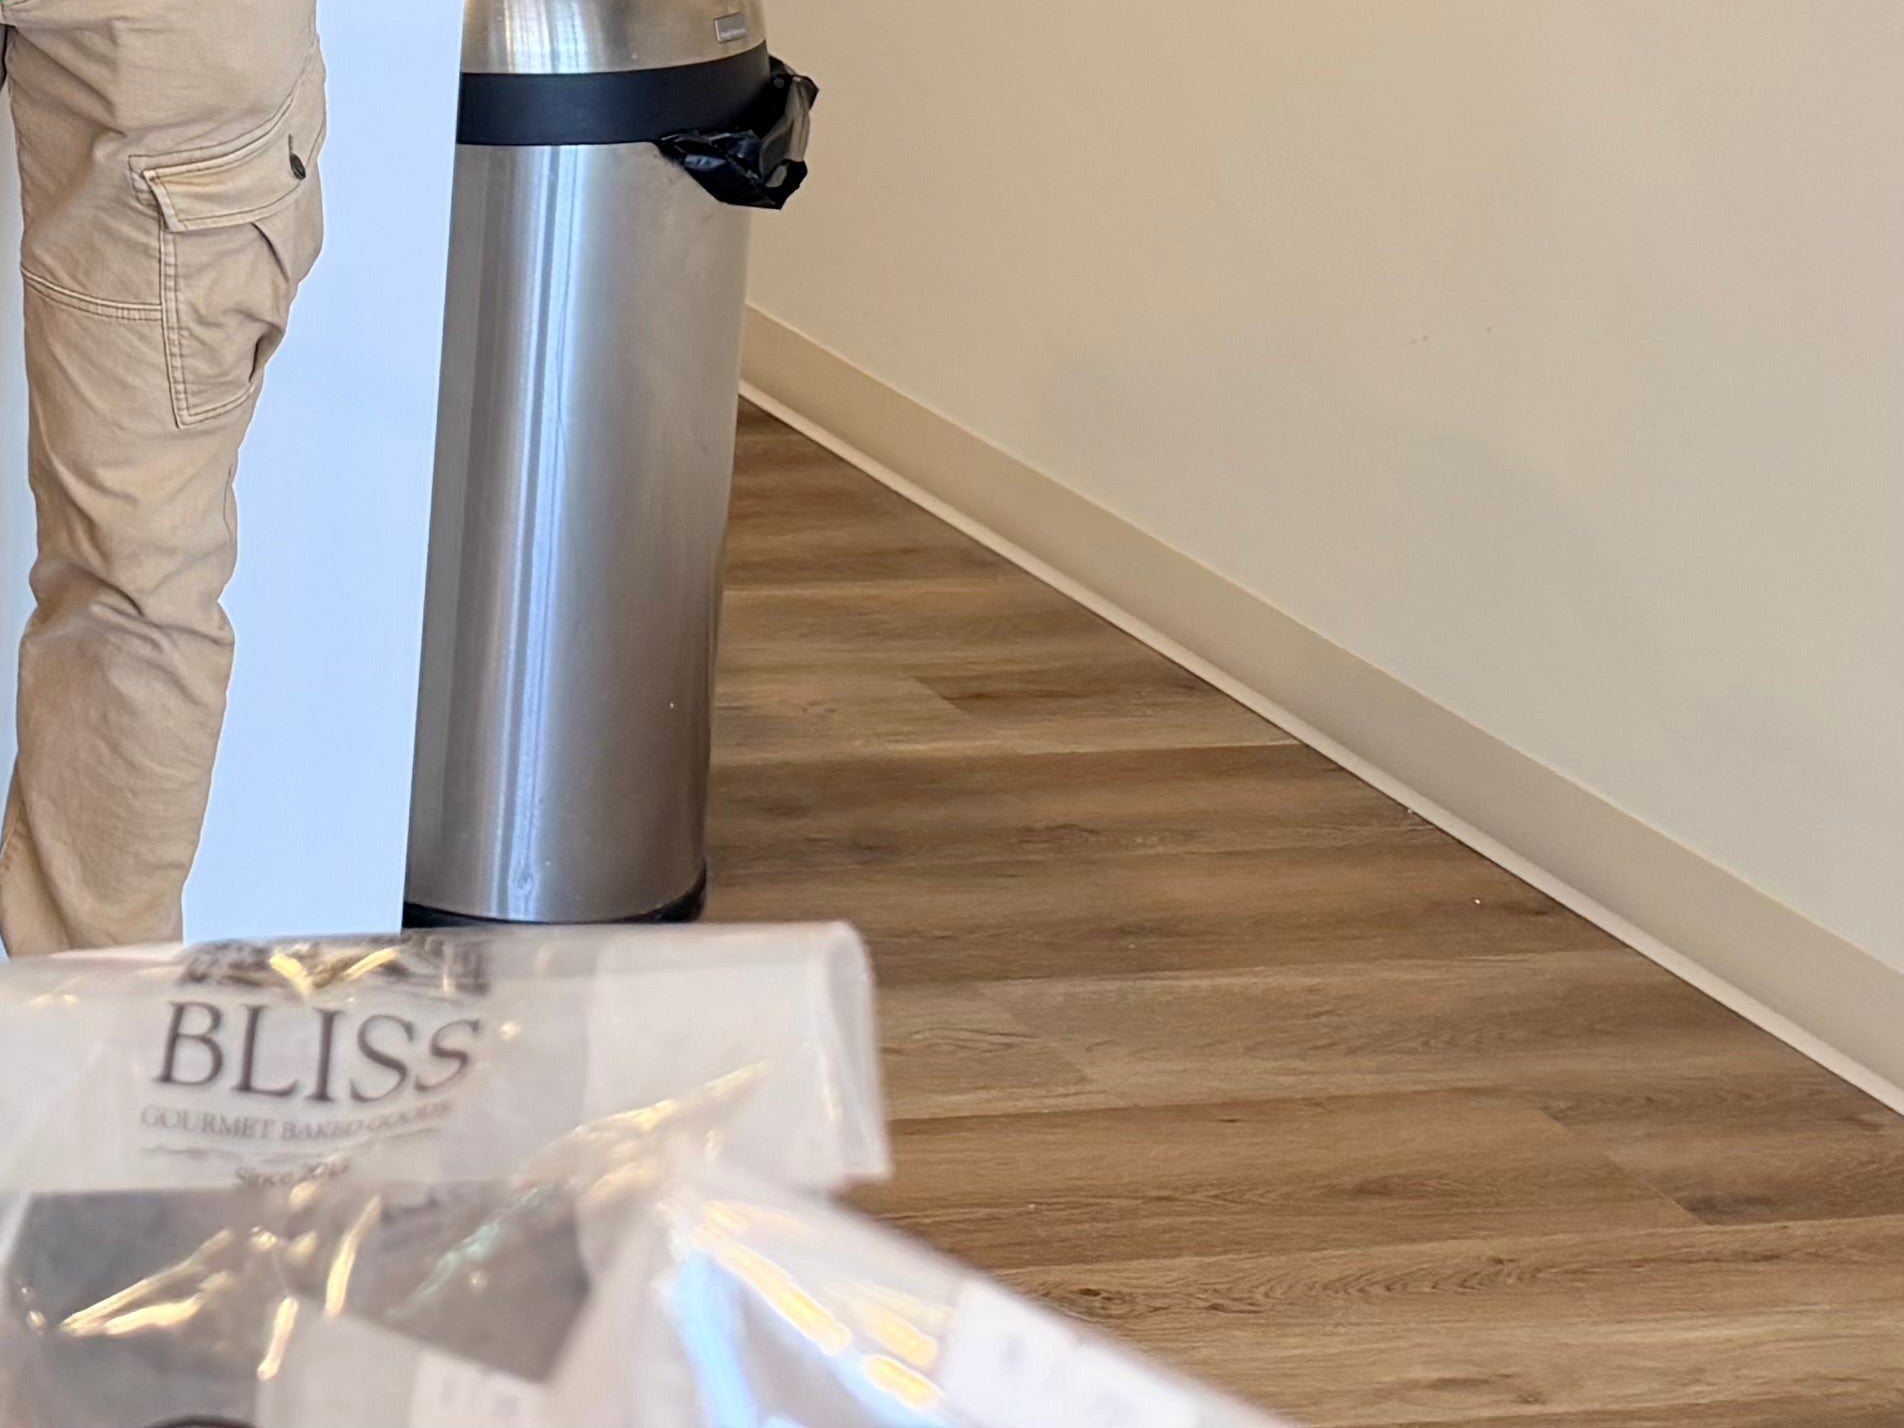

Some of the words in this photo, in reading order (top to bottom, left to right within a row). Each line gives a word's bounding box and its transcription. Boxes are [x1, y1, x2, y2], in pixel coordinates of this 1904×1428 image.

[153, 1000, 481, 1104] BLISS
[140, 1104, 276, 1140] GOURMET
[281, 1118, 363, 1142] BAKED
